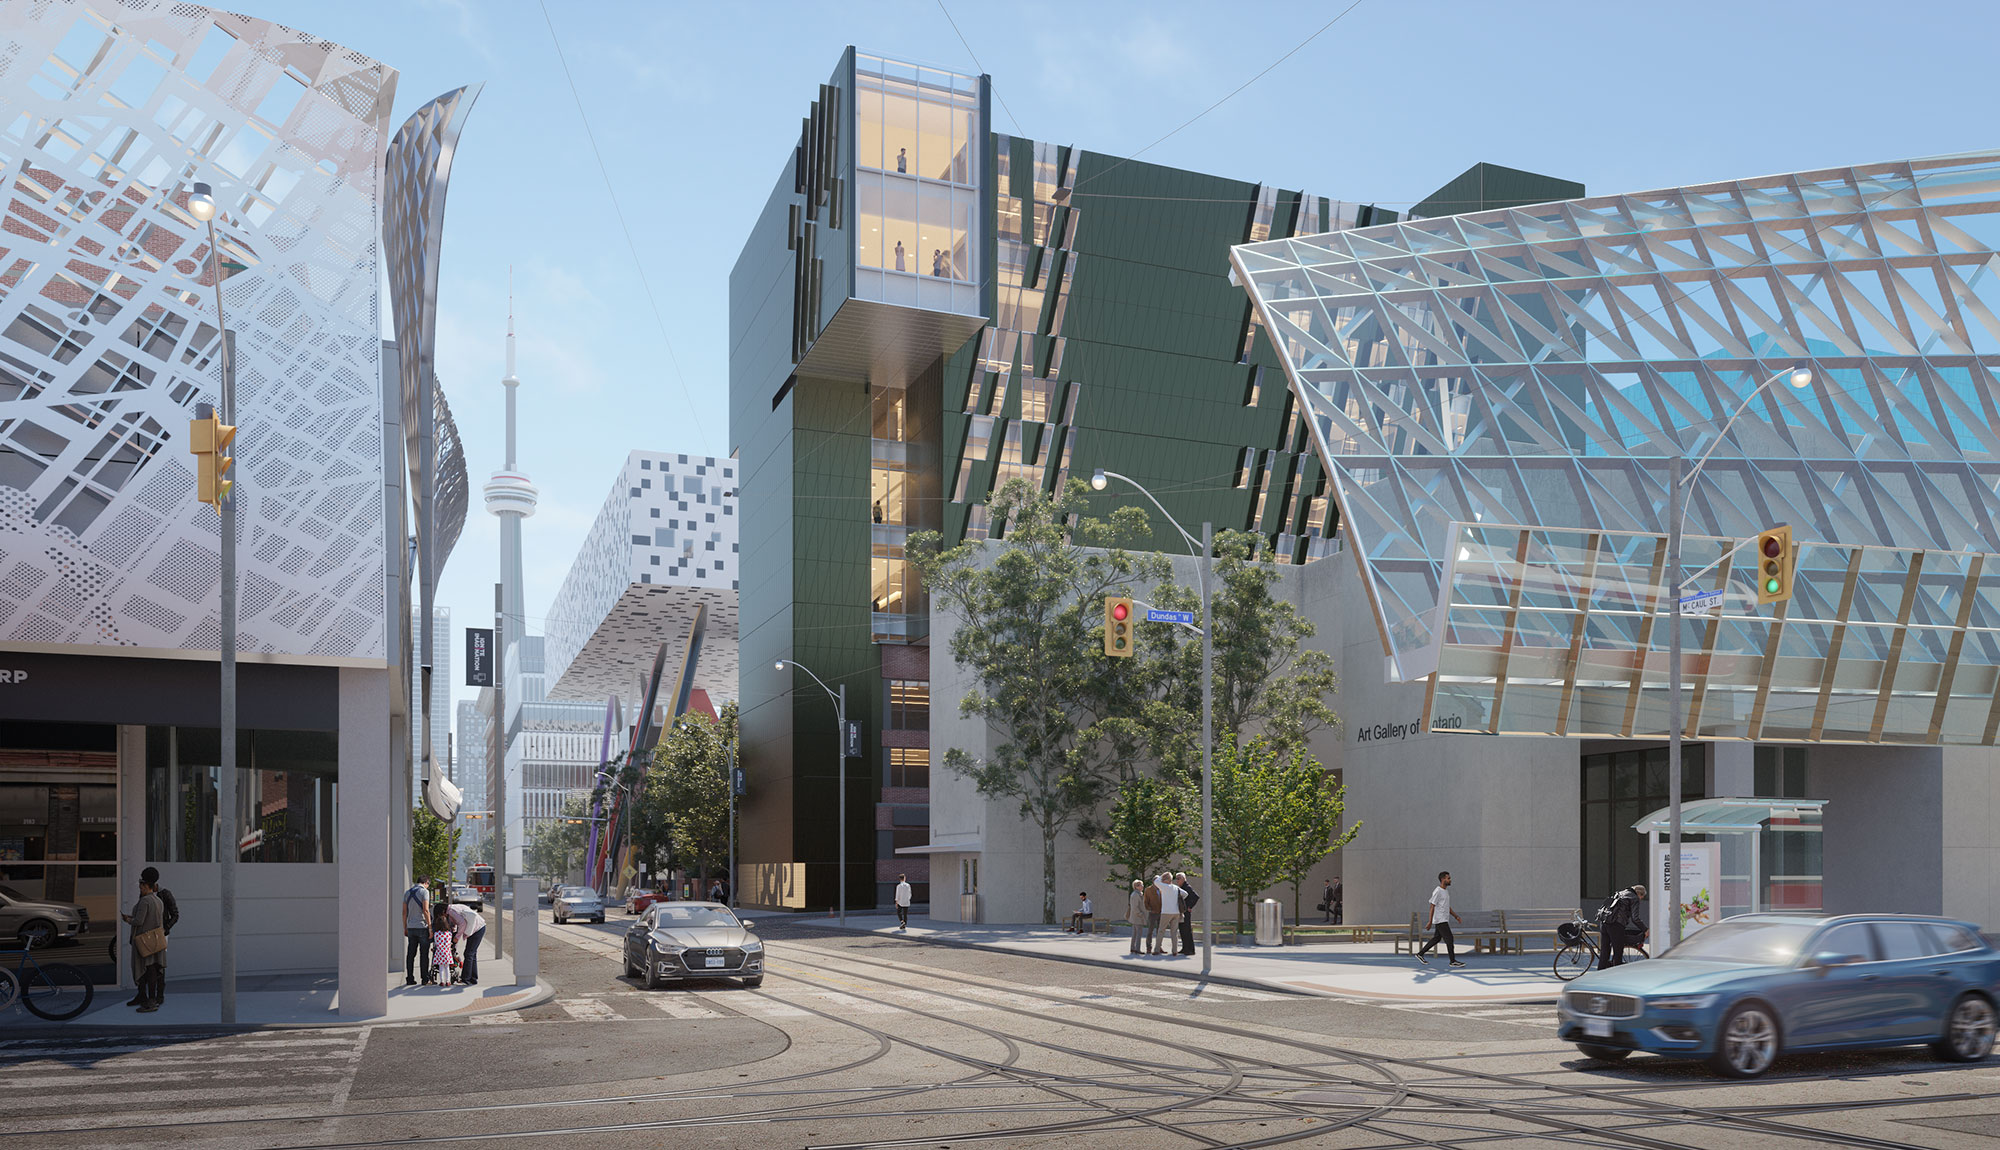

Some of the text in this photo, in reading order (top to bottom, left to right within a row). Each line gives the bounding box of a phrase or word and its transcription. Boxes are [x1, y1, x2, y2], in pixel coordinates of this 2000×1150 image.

[1150, 612, 1177, 621] Dundas
[1182, 614, 1190, 622] W
[1358, 713, 1462, 742] Art Gallery of ntario
